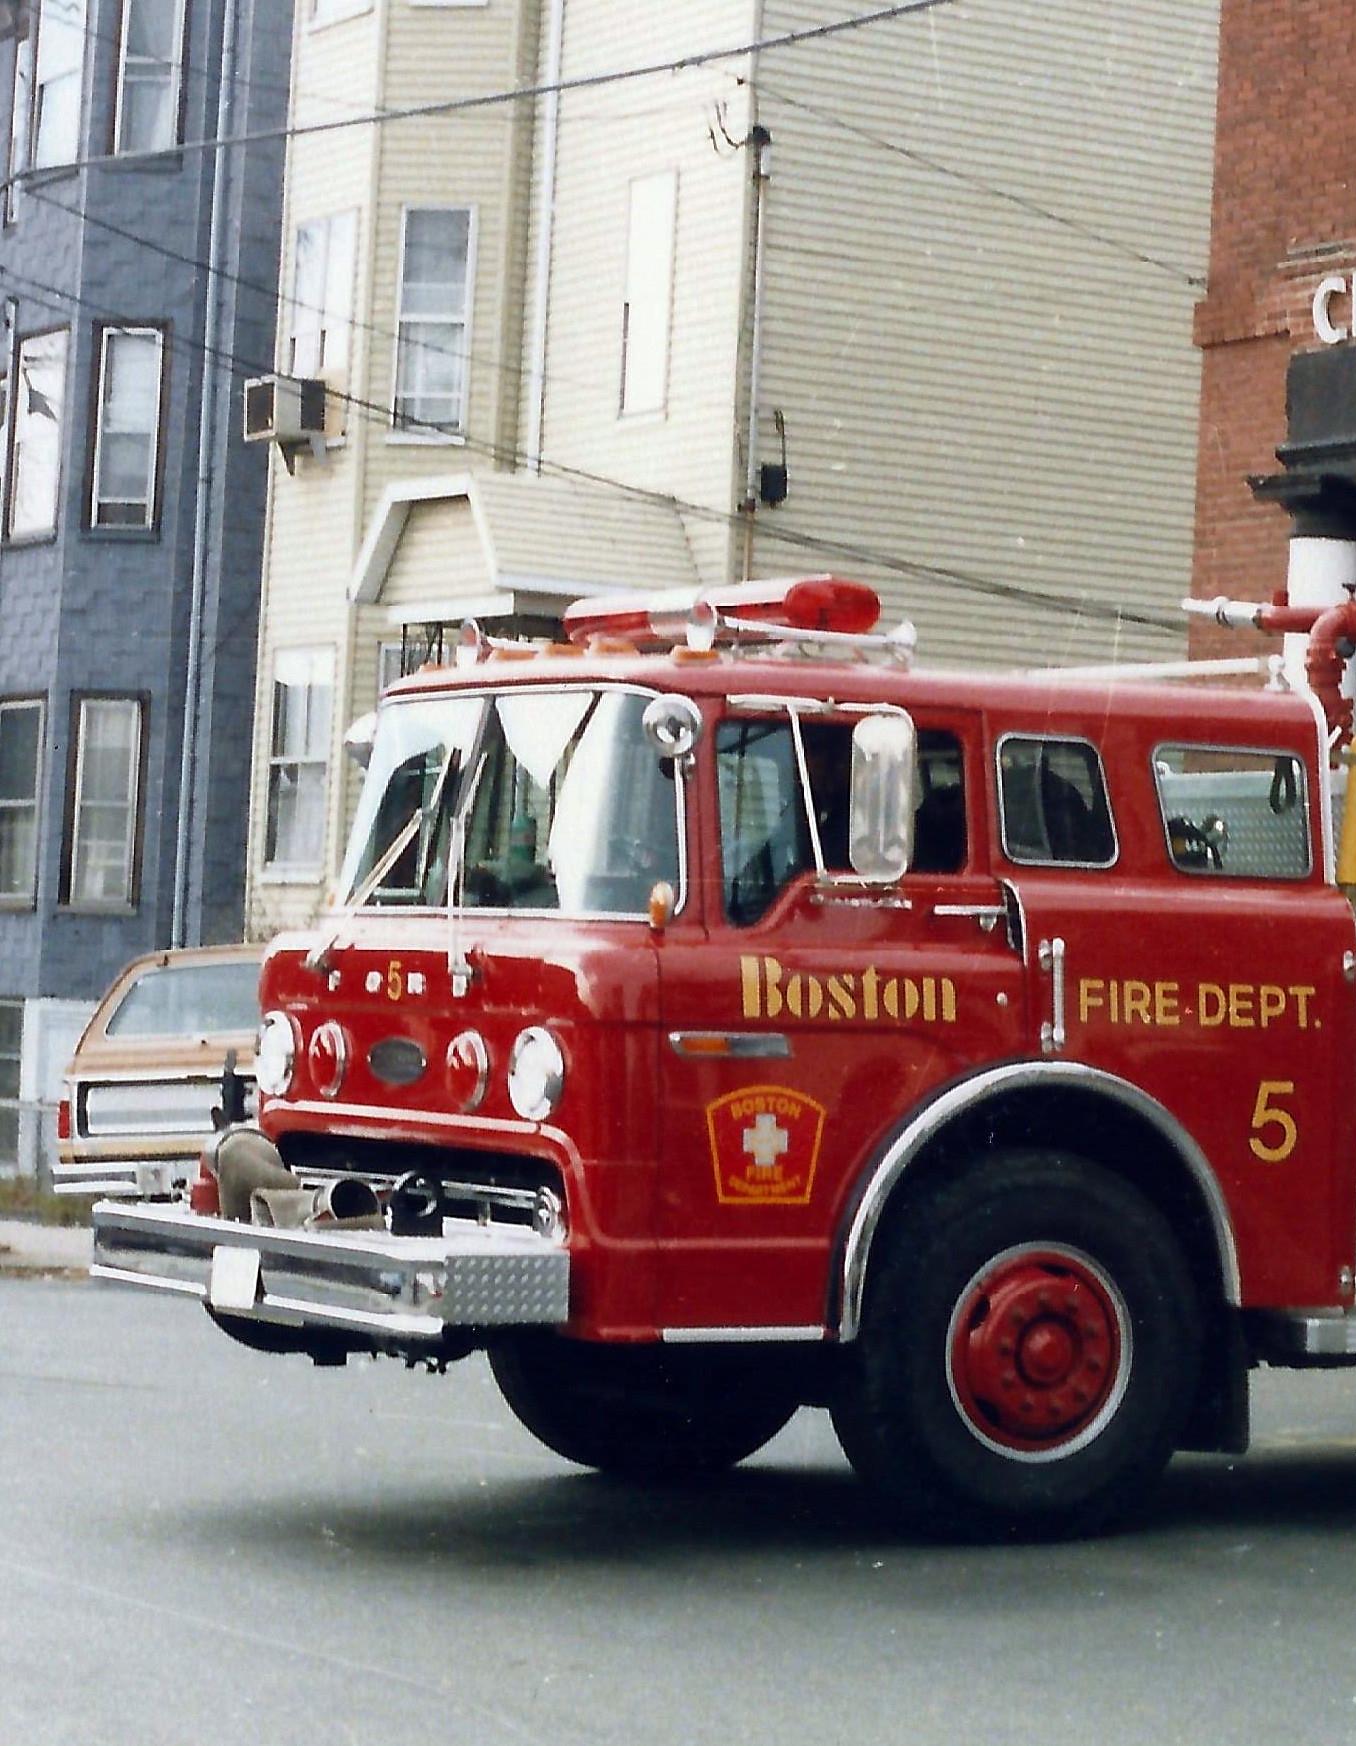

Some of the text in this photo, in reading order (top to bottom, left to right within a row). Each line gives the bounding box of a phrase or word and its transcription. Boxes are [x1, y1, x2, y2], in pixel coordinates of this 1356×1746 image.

[388, 960, 402, 1001] 5
[740, 956, 956, 1022] Boston
[1079, 978, 1322, 1029] FIRE DEPT.
[1249, 1080, 1298, 1161] 5
